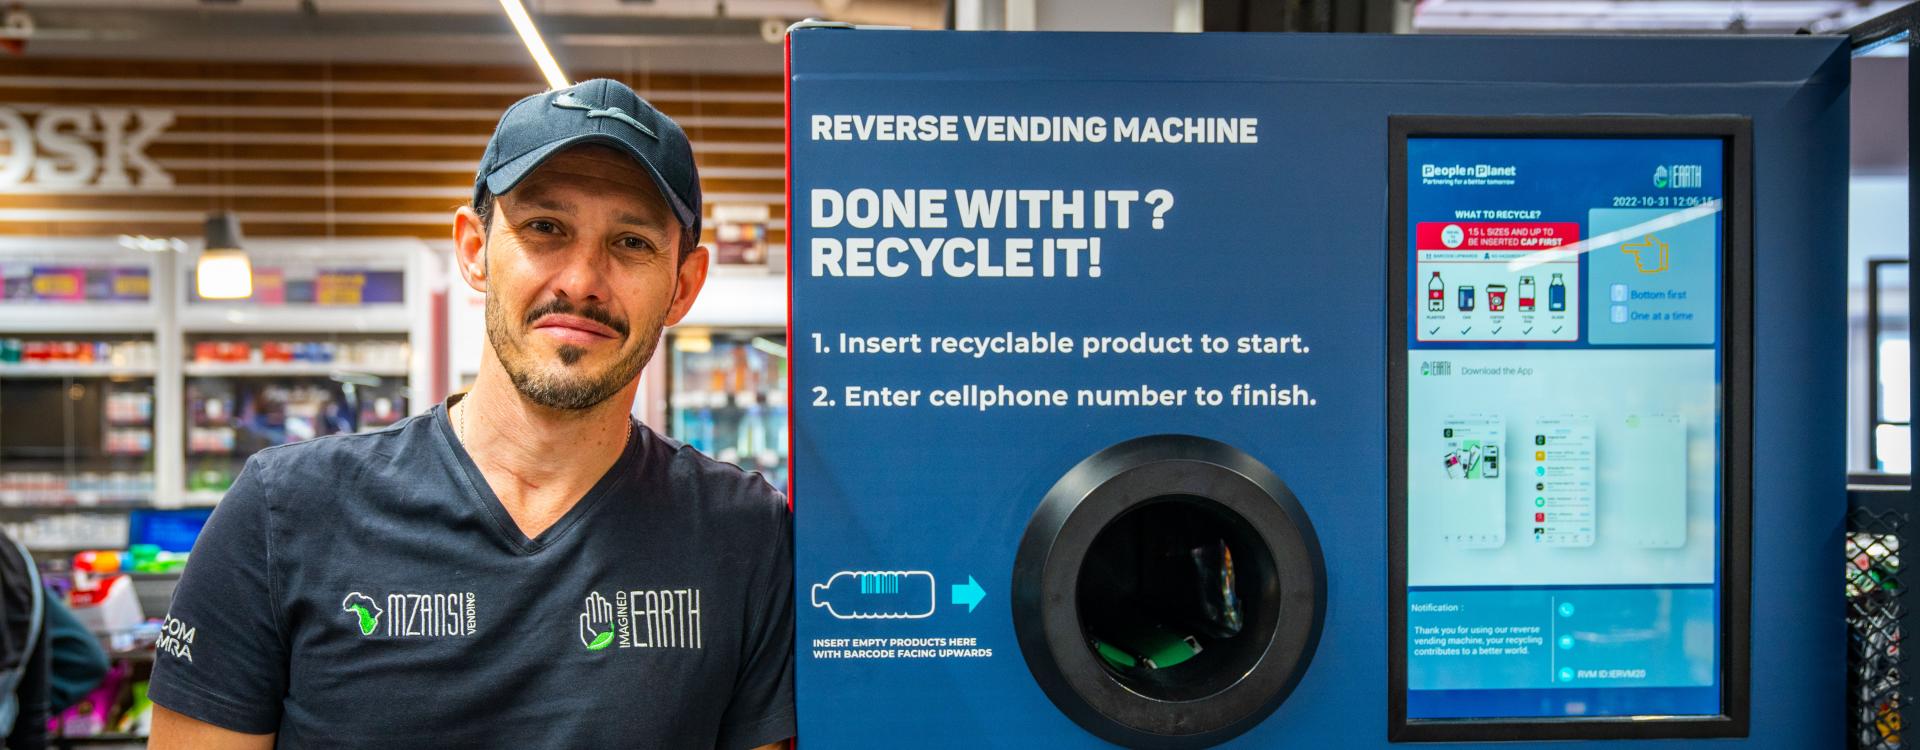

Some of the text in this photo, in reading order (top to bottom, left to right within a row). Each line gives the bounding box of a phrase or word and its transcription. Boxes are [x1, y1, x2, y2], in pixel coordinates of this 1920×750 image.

[811, 115, 1258, 144] REVERSE VENDING MACHINE
[1475, 164, 1516, 178] Planet
[1672, 164, 1702, 188] EARTH
[1423, 178, 1454, 186] Partnering
[1612, 195, 1669, 207] 2022-10-31
[811, 188, 947, 229] DONE
[955, 189, 1085, 230] WITH
[1455, 210, 1541, 219] WHAT TO RECYCLE?
[1486, 227, 1510, 236] SIZES
[1511, 227, 1529, 236] AND
[1529, 227, 1542, 236] UP
[1542, 227, 1554, 236] TO
[1468, 237, 1479, 246] BE
[1480, 237, 1519, 246] INSERTED
[1520, 237, 1537, 246] CAP
[1538, 237, 1564, 246] FIRST
[811, 237, 1102, 278] RECYCLE IT!
[1631, 289, 1688, 300] Bottom first
[1631, 311, 1694, 321] One at a time
[811, 331, 1310, 359] 1. Insert recyclable product to start.
[1461, 366, 1534, 377] Download the App
[812, 383, 1317, 412] 2. Enter cellphone number to finish.
[1411, 603, 1459, 612] Notification
[387, 591, 477, 637] MZANSI VENDING
[616, 588, 702, 649] IMAGINED EARTH
[1414, 625, 1541, 636] Thank you for using our reverse
[813, 637, 977, 648] INSERT EMPTY PRODUCTS HERE
[1414, 635, 1544, 646] vending machine, your recycling
[813, 648, 992, 659] WITH BARCODE FACING UPWARDS
[1414, 647, 1461, 656] contributes
[1461, 647, 1471, 656] to
[1479, 646, 1503, 656] better
[1504, 646, 1530, 655] world.
